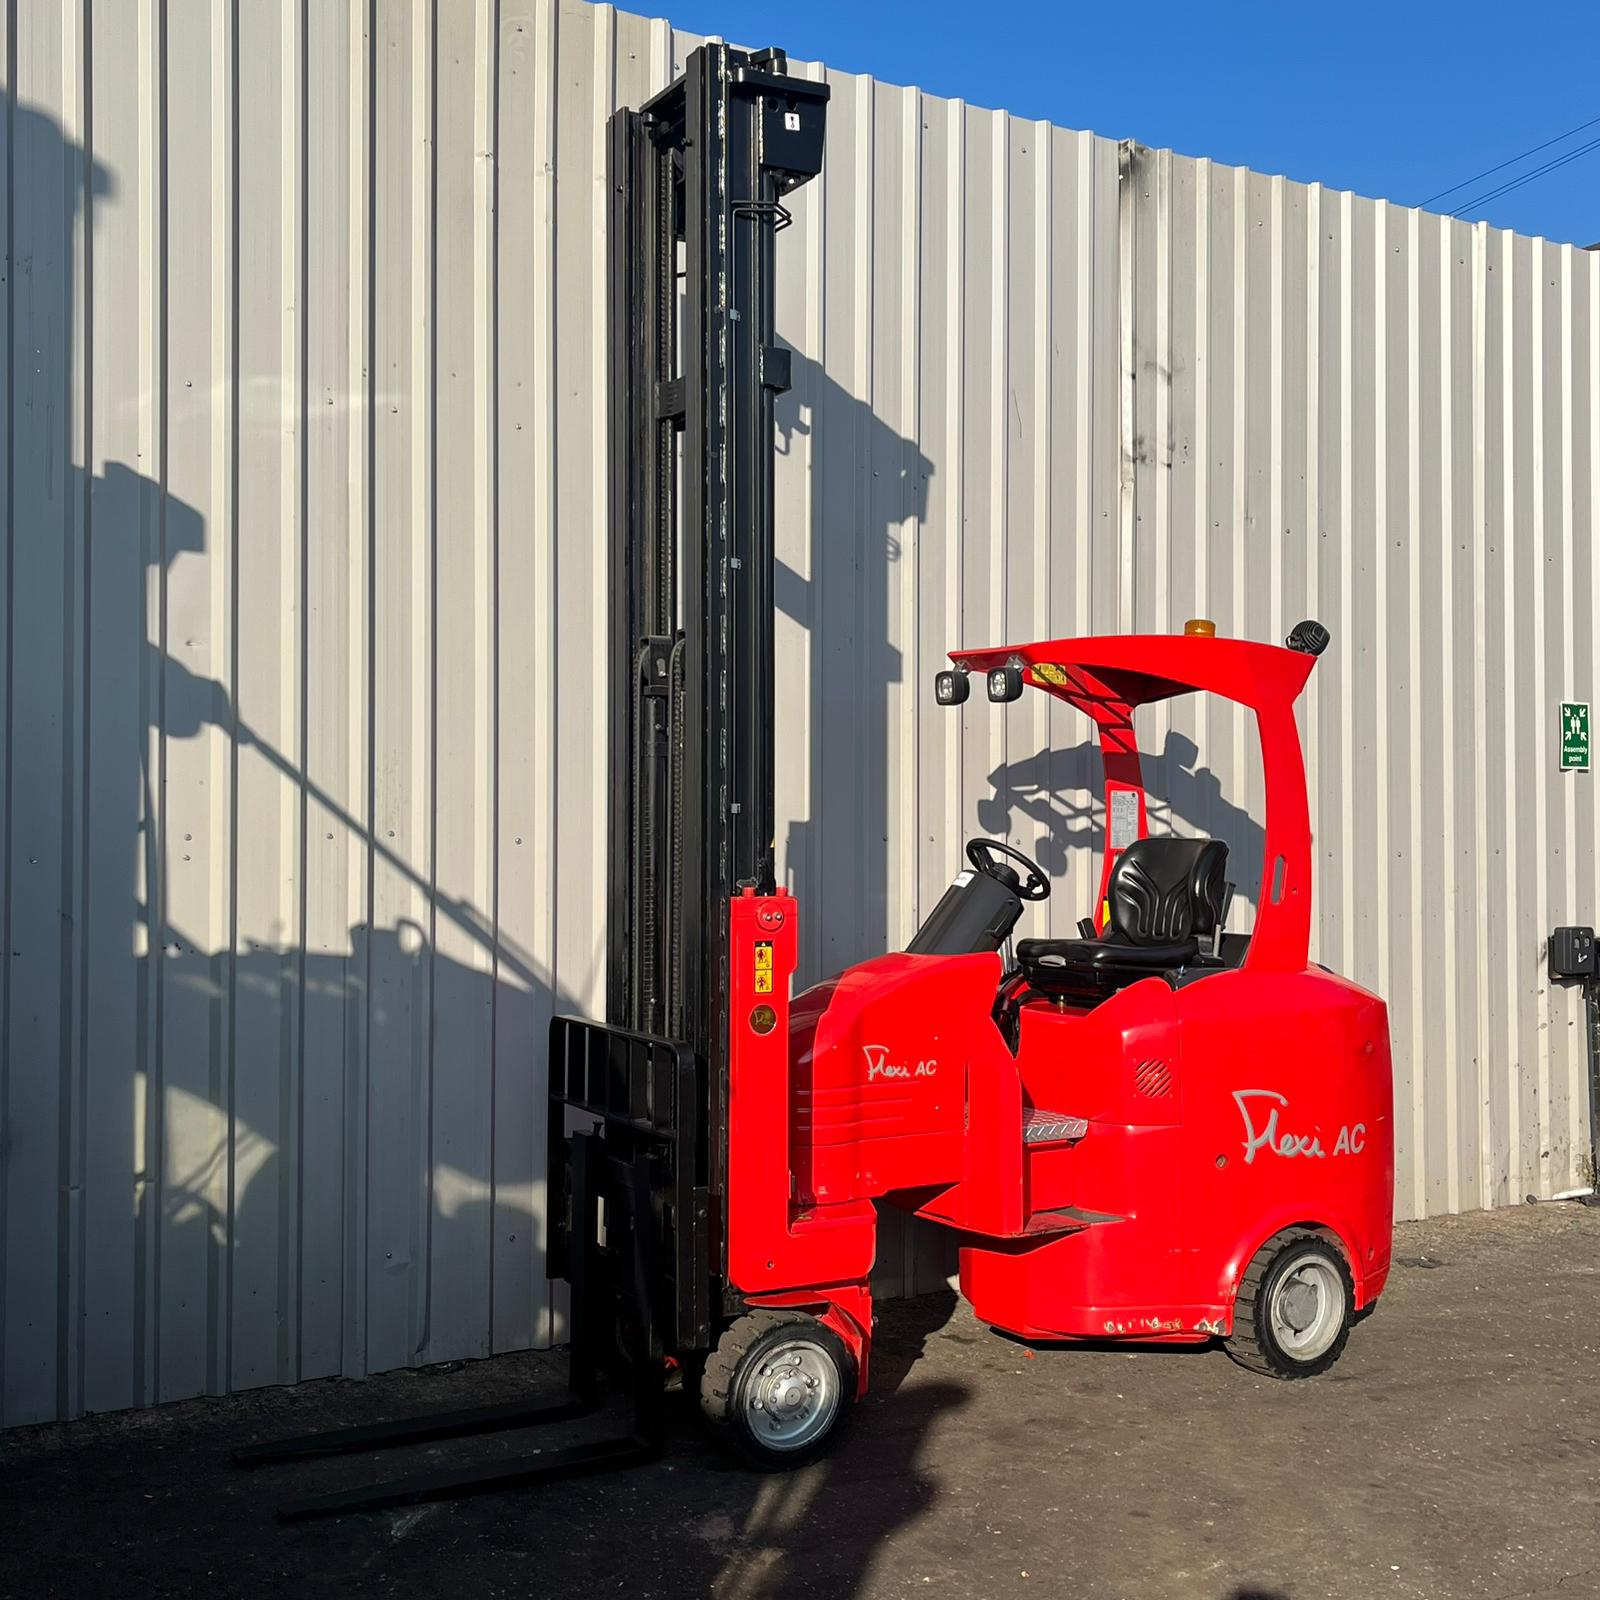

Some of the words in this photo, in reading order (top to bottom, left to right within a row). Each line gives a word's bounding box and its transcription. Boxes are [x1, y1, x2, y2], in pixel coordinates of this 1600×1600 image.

[1564, 745, 1588, 755] Assembly
[1569, 755, 1582, 763] point
[862, 1044, 911, 1082] Flexi
[915, 1059, 938, 1077] AC
[1231, 1089, 1327, 1165] Flexi
[1332, 1122, 1366, 1157] AC
